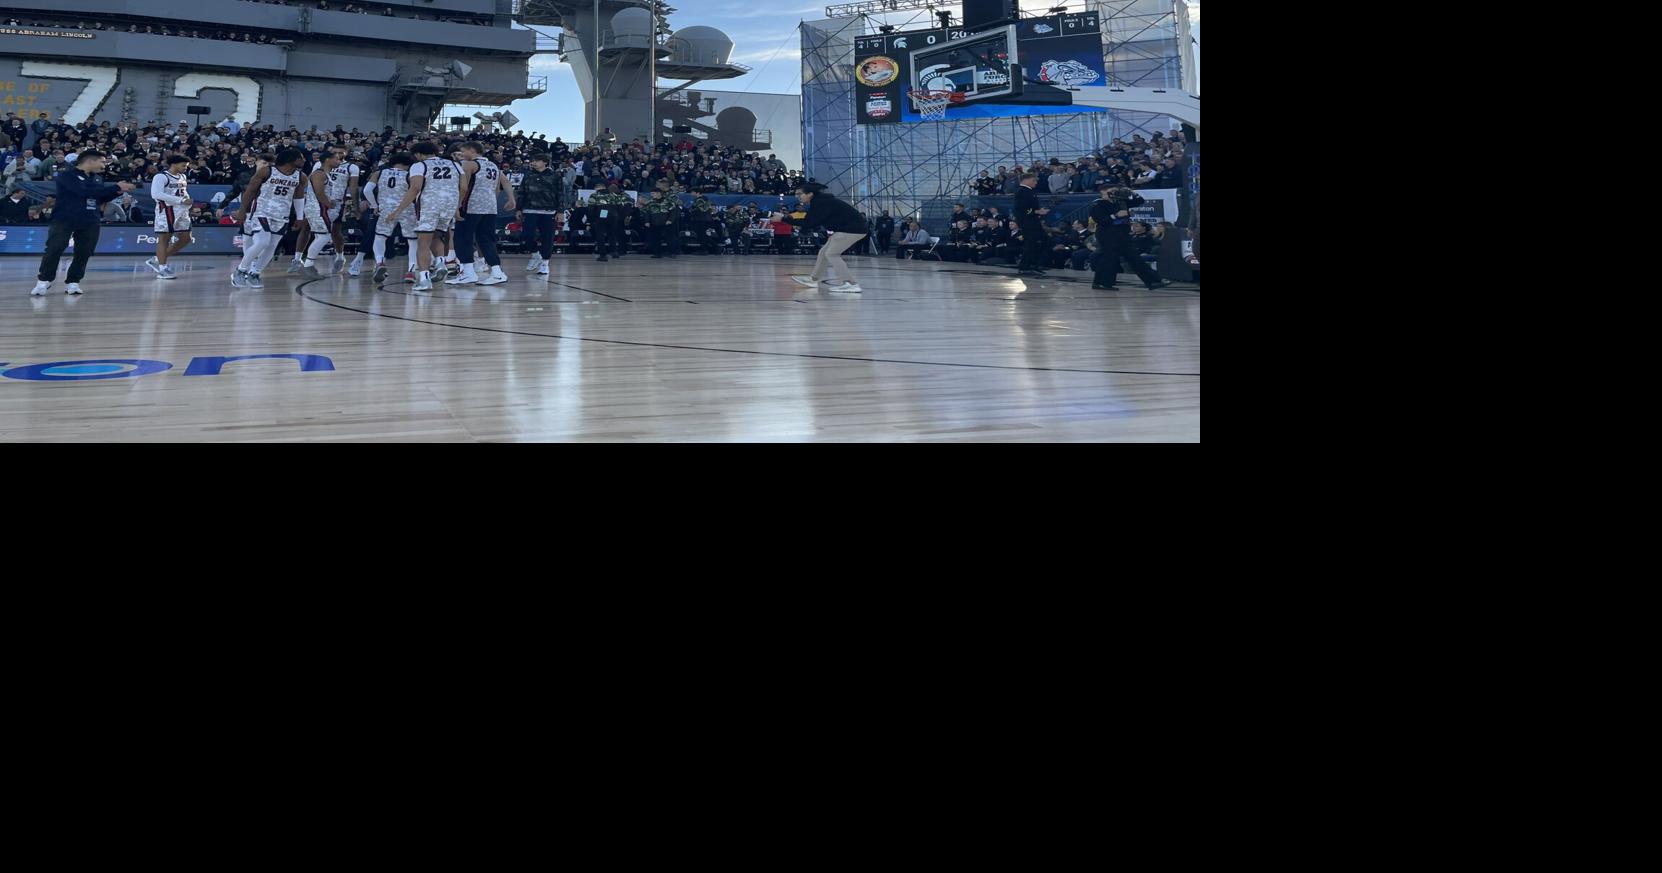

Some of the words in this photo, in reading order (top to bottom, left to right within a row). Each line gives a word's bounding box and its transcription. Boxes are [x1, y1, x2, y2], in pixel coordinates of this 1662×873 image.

[926, 35, 936, 44] 0
[433, 166, 452, 179] 22
[486, 168, 497, 180] 33
[387, 176, 396, 188] 0
[175, 188, 184, 197] 45
[274, 186, 289, 196] 55
[0, 353, 336, 381] on
